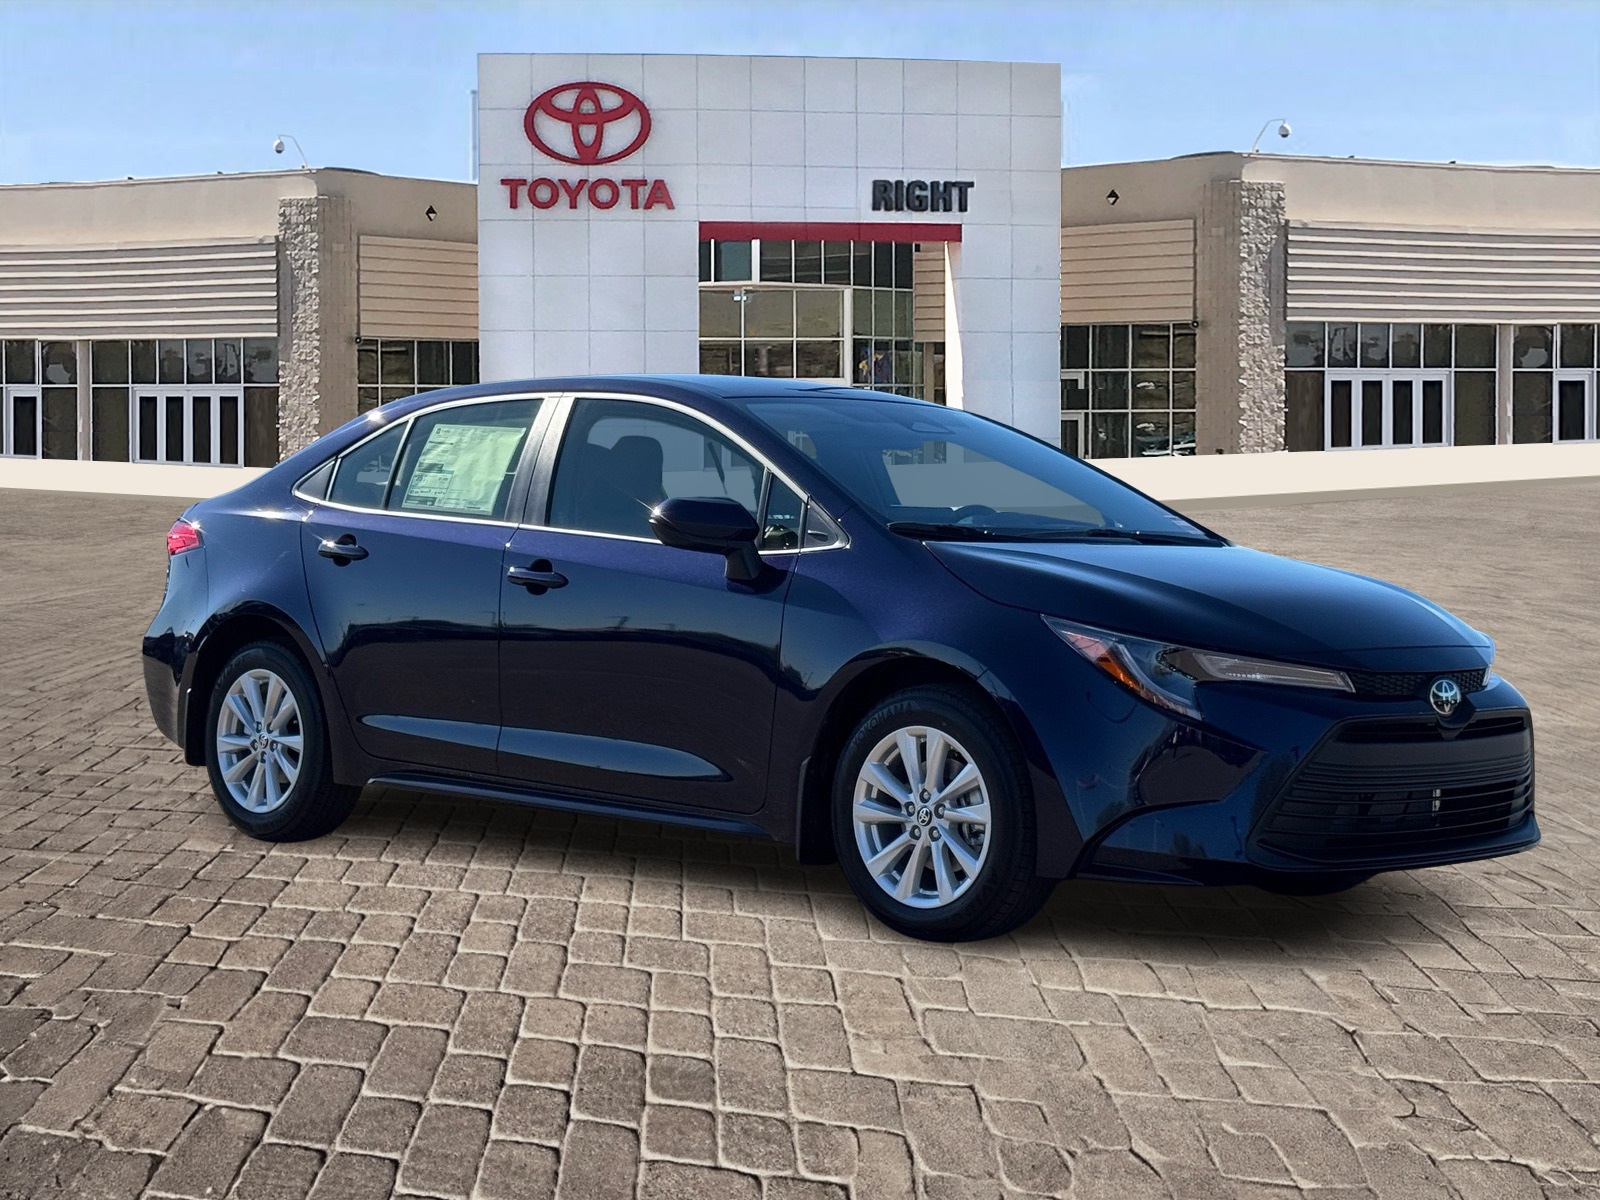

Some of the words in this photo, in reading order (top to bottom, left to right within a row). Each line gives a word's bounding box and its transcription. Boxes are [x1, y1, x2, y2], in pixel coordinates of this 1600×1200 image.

[500, 177, 675, 210] TOYOTA
[872, 179, 975, 213] RIGHT
[851, 701, 913, 746] YOKOHAMA
